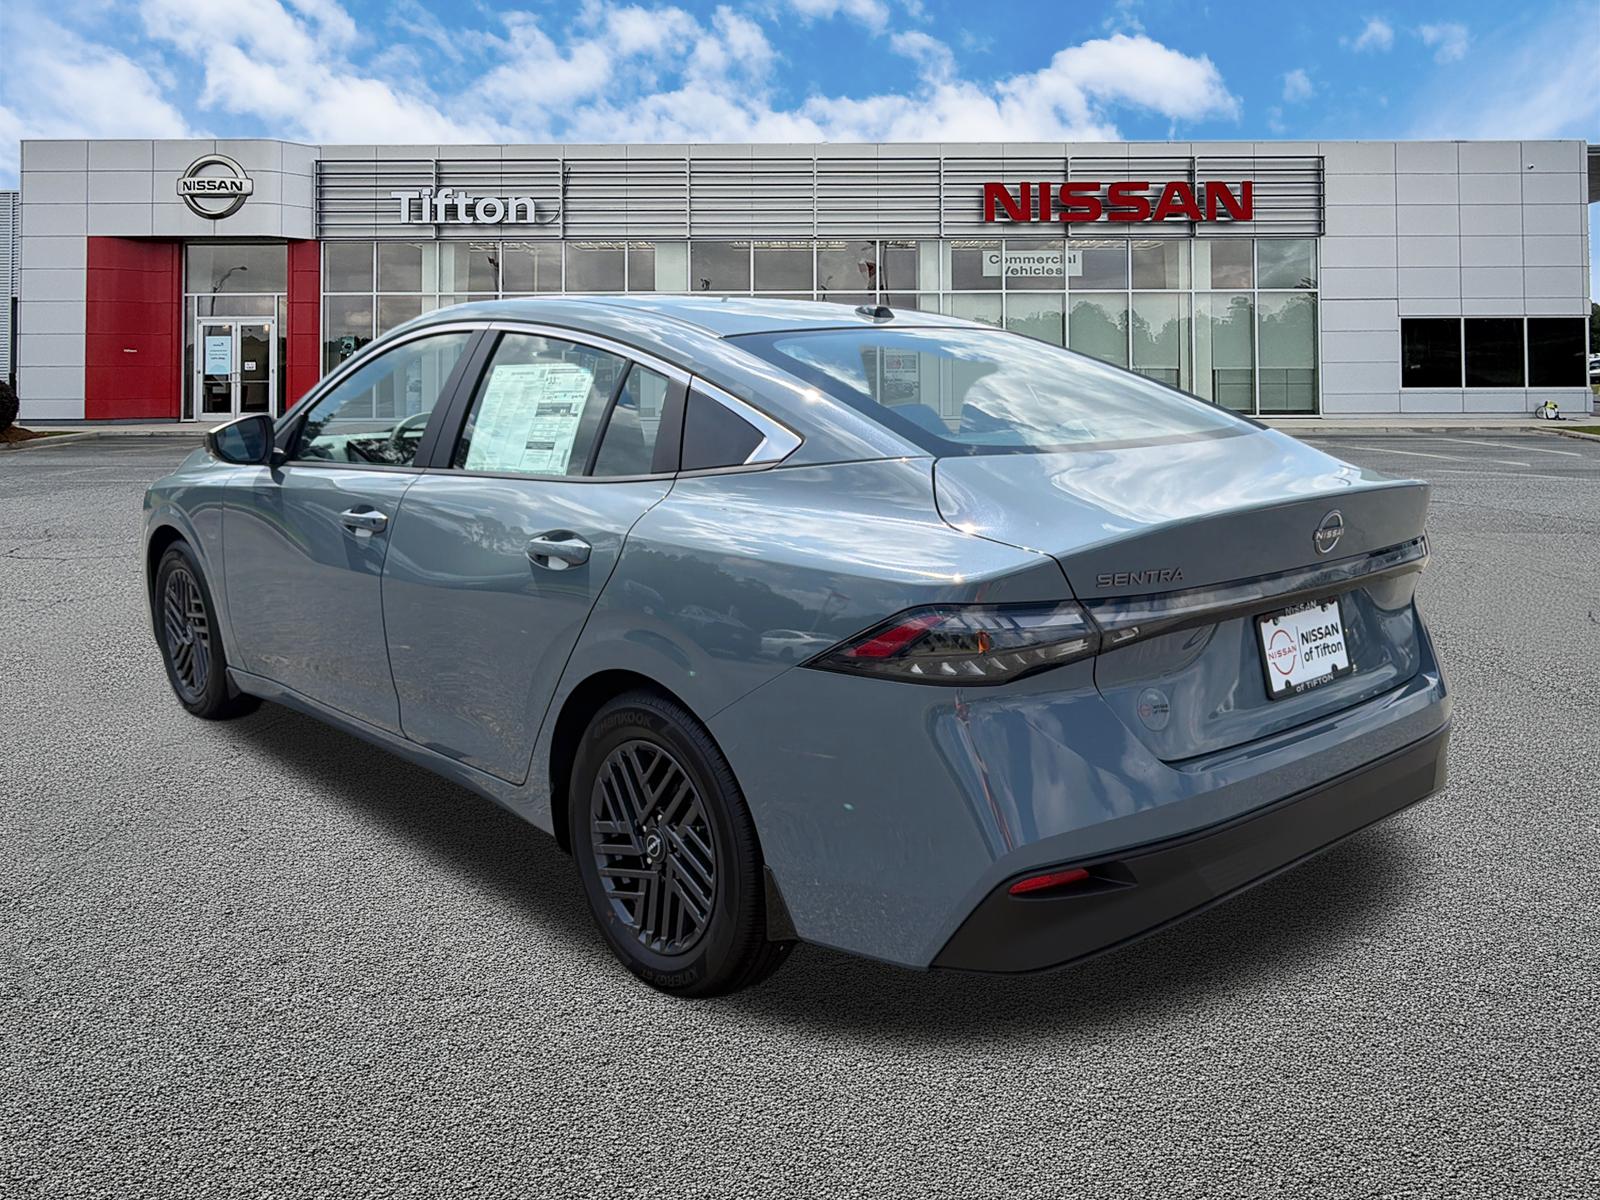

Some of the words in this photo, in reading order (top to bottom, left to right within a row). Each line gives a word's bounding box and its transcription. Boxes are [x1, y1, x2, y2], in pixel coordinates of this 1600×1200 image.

[183, 180, 243, 192] NISSAN
[391, 188, 535, 224] Tifton
[983, 181, 1253, 222] NISSAN
[1097, 567, 1184, 588] SENTRA
[1284, 600, 1317, 615] NISSAN
[1300, 622, 1340, 645] NISSAN
[1268, 645, 1297, 660] NISSAN
[1304, 646, 1313, 662] of
[1315, 641, 1343, 658] Tifton
[1296, 684, 1304, 693] of
[1306, 673, 1334, 689] TIFTON
